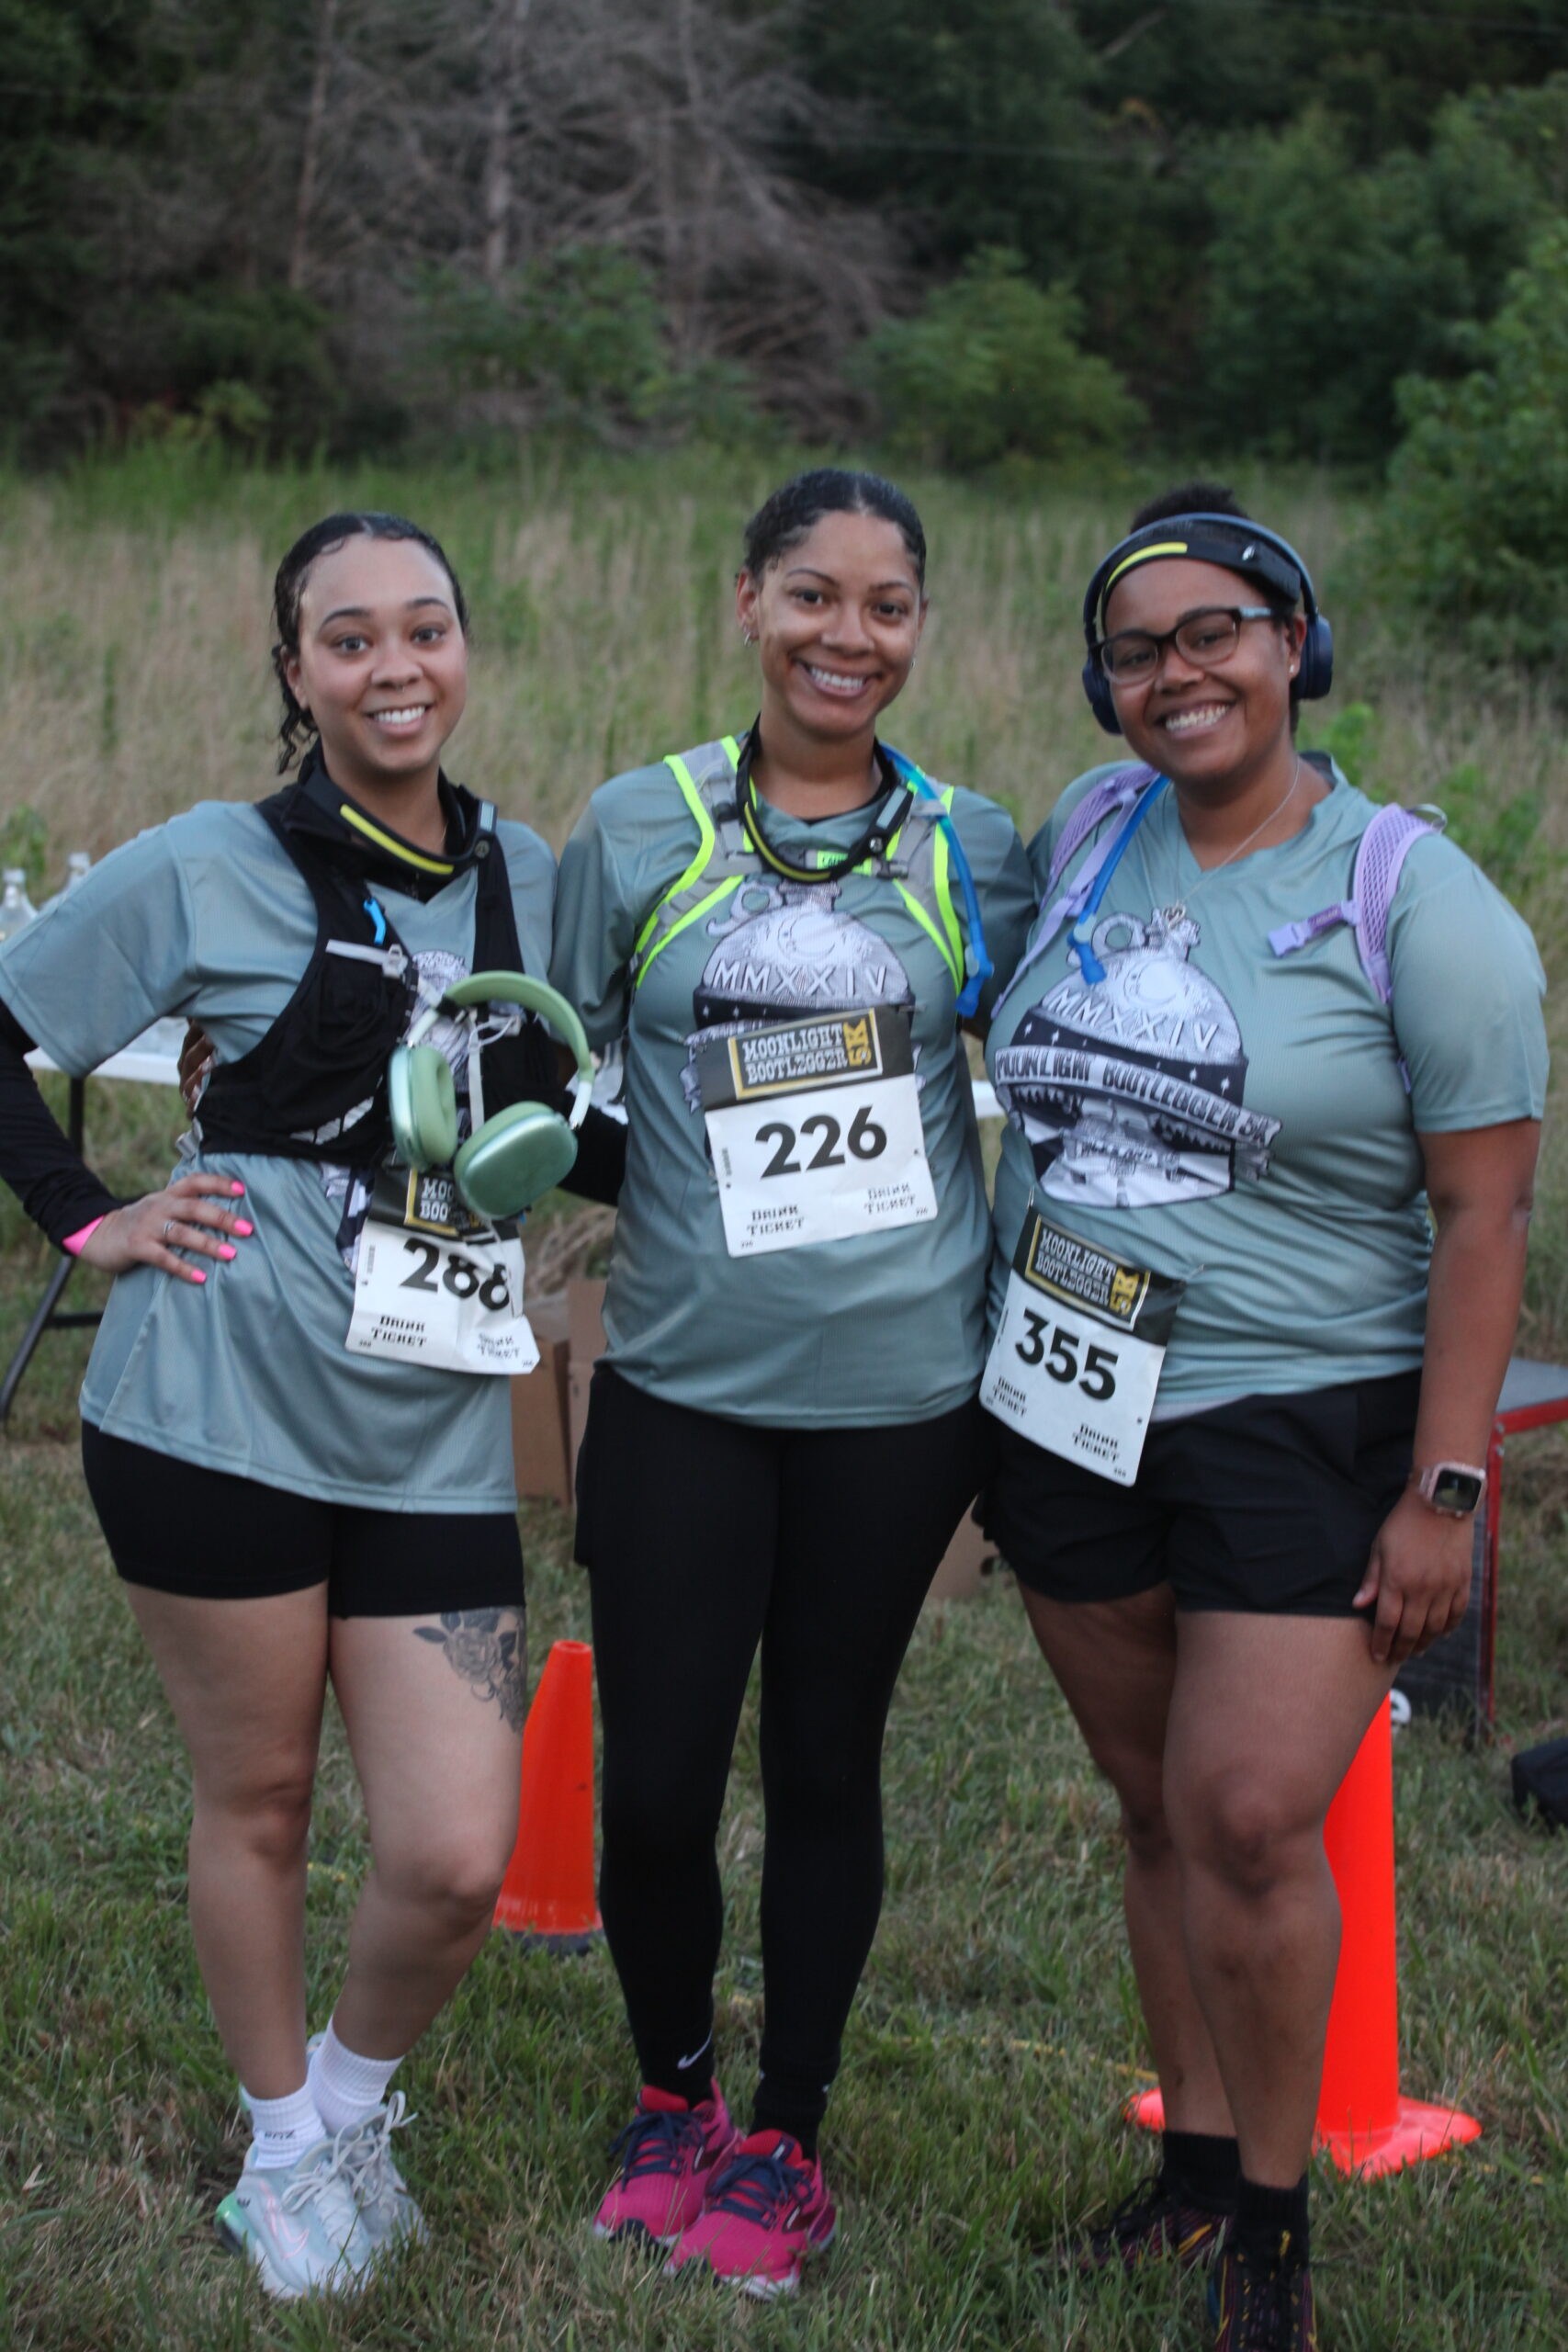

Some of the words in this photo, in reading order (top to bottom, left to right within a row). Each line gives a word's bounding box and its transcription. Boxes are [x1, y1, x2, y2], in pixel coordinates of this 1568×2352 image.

[713, 960, 886, 996] MMXXIV
[1047, 987, 1218, 1052] MMXXIV
[742, 1023, 843, 1063] MOONLIGHT
[746, 1046, 848, 1085] BOOTLEGGER
[998, 1047, 1091, 1082] MOONLIGHT
[1103, 1060, 1240, 1133] BOOTLEGGER
[755, 1103, 887, 1180] 226
[747, 1216, 804, 1236] TICKET
[1039, 1227, 1117, 1286] MOONLIGHT
[1035, 1250, 1111, 1306] BOOTLEGGER
[371, 1328, 427, 1347] TICKET
[1015, 1307, 1119, 1401] 355
[992, 1385, 1028, 1418] TICKET
[1072, 1432, 1120, 1463] TICKET
[1079, 1423, 1119, 1450] DRINK
